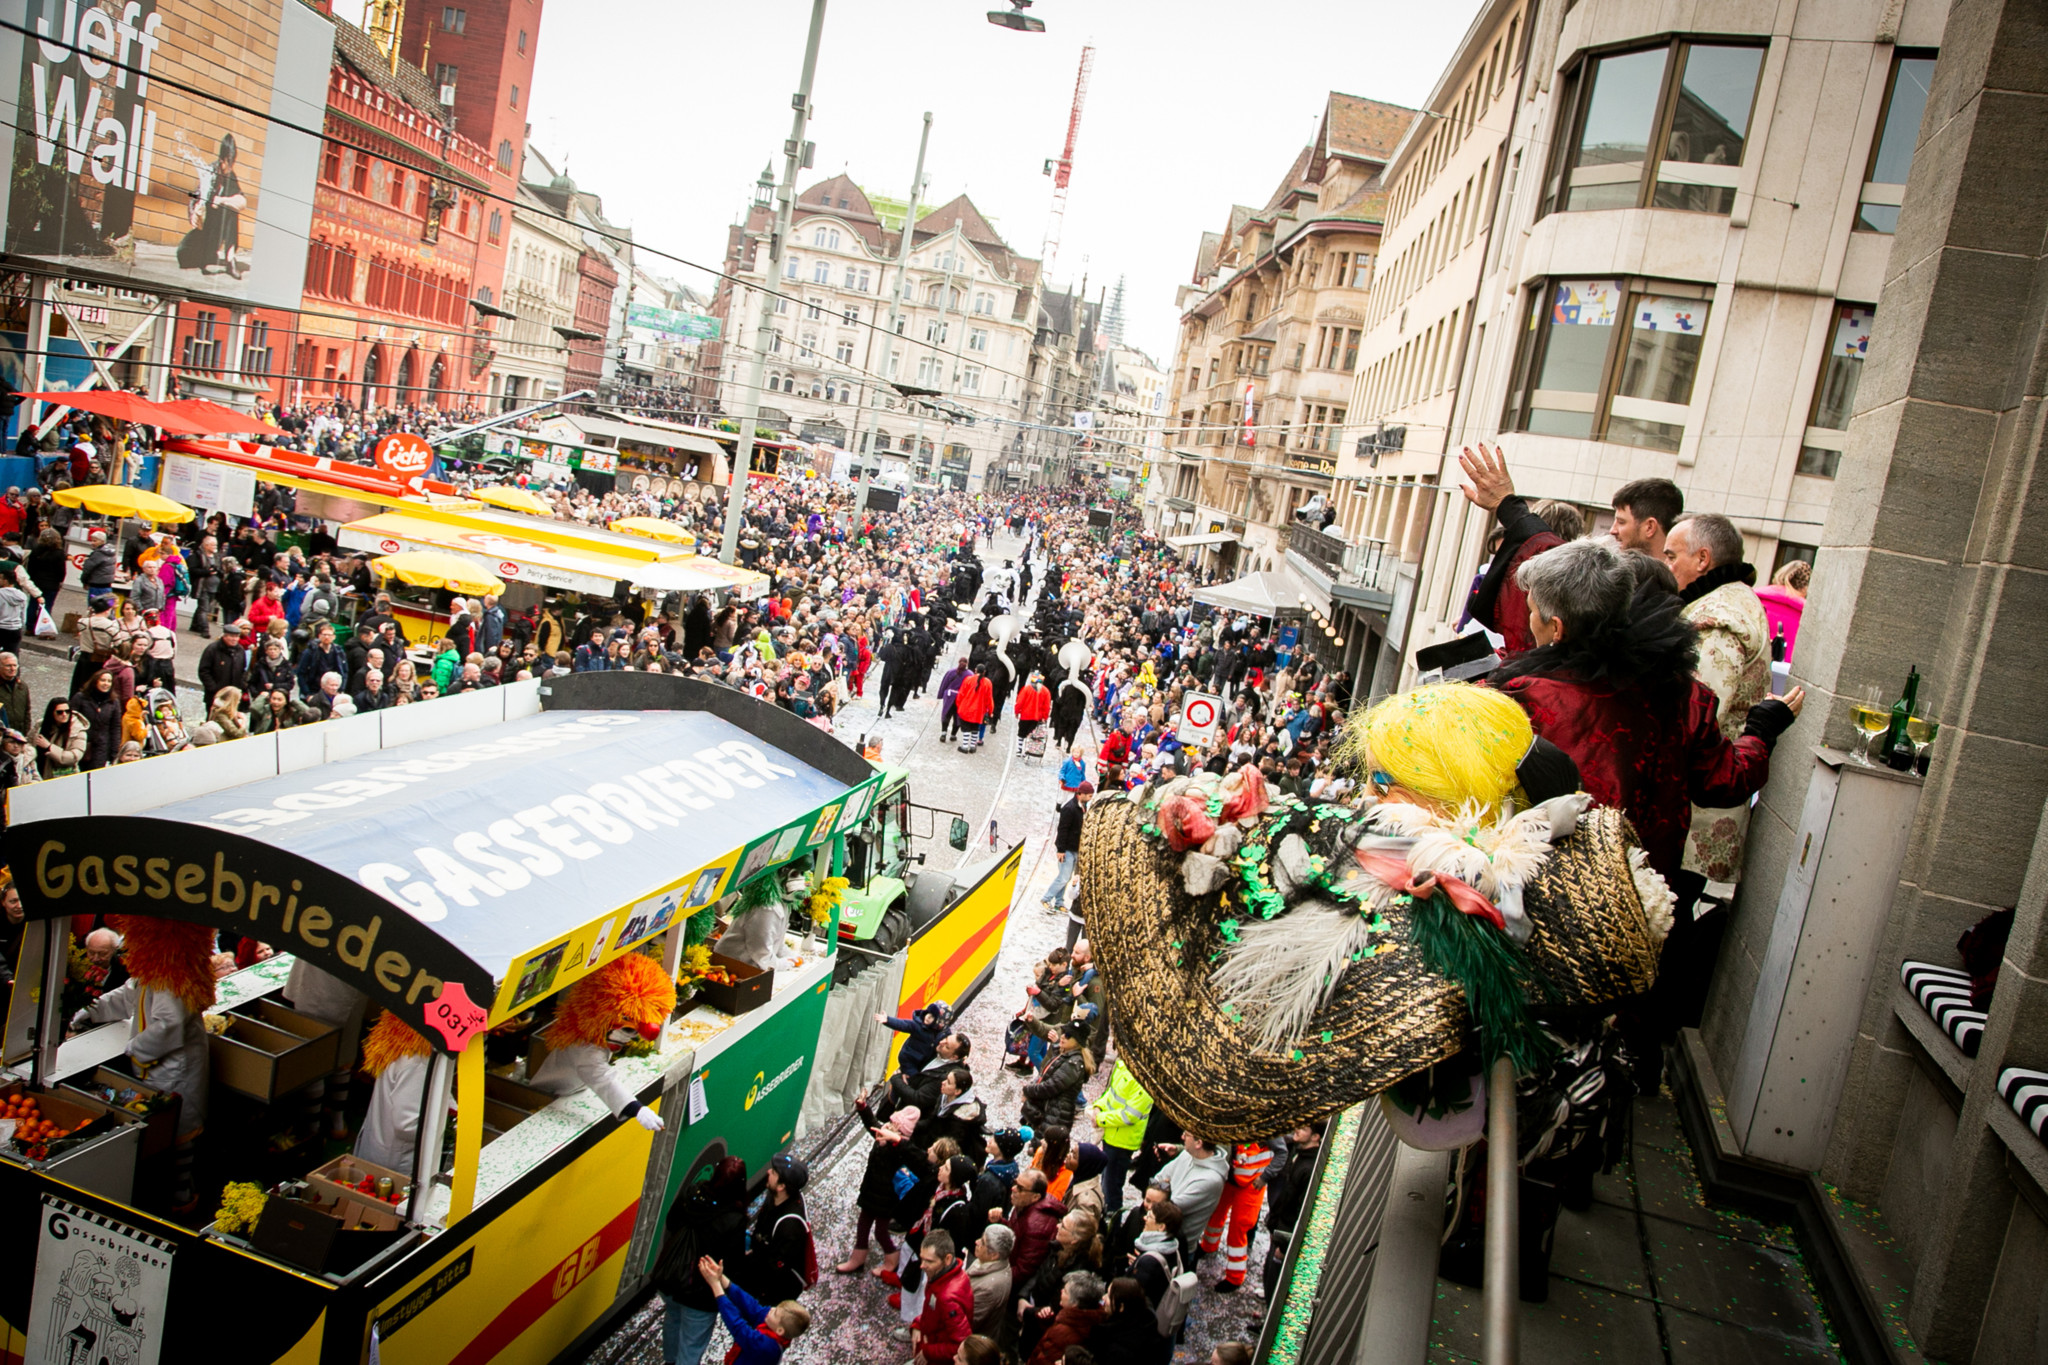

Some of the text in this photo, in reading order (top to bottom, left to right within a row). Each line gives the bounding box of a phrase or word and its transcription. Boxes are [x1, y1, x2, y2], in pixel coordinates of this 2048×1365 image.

[37, 0, 162, 98] Jeff
[32, 62, 157, 195] Wall
[383, 438, 428, 471] Eiche
[358, 740, 797, 923] GASSEBRIEDER
[36, 839, 444, 1005] Gassebrieder
[437, 1003, 469, 1038] 031
[48, 1212, 168, 1270] Gassebrieder
[552, 1235, 601, 1300] GB
